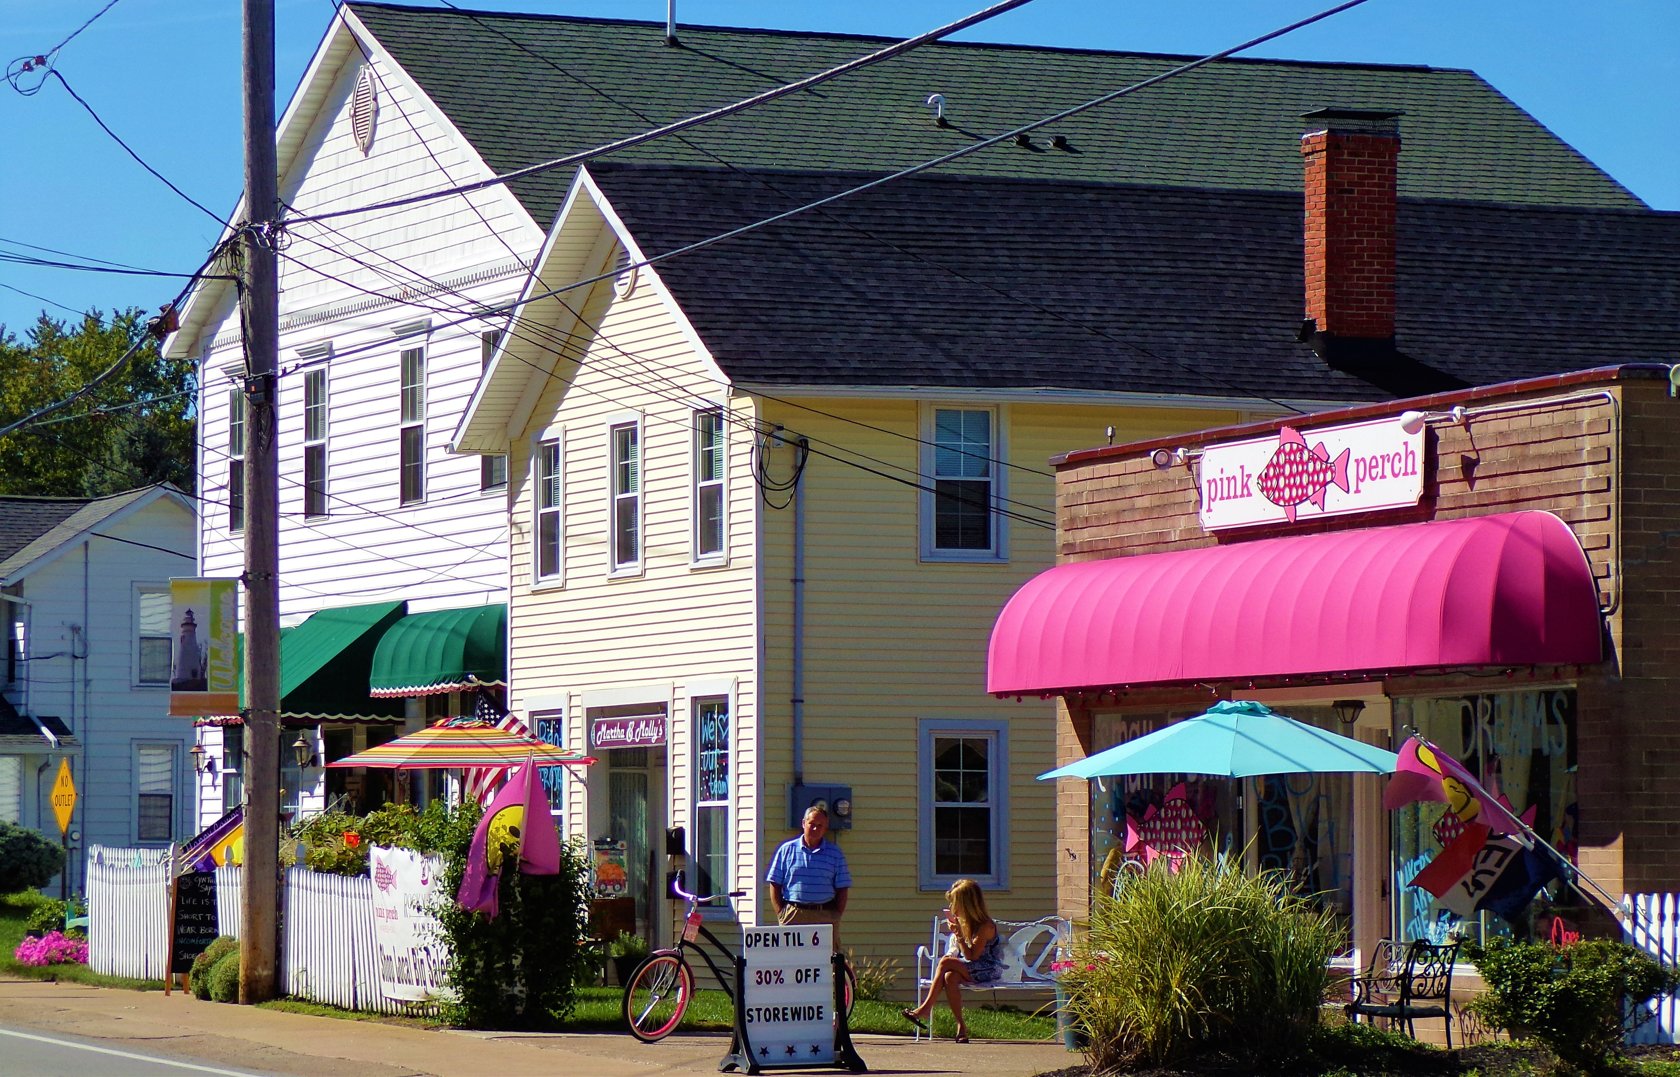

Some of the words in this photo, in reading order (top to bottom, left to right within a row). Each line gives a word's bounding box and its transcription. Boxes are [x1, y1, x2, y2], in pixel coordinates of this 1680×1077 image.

[1206, 465, 1252, 513] pink
[1354, 441, 1418, 494] perch
[209, 588, 235, 690] Welcome
[596, 723, 626, 745] Martha
[626, 720, 635, 742] &
[634, 719, 664, 744] Molly's
[701, 712, 715, 744] We
[1460, 690, 1569, 762] DREAMS
[60, 775, 69, 788] NO
[54, 794, 73, 807] OUTLET
[177, 909, 203, 921] SHORT
[206, 912, 217, 921] TO
[177, 923, 198, 936] WEAR
[745, 932, 780, 949] OPEN
[783, 931, 804, 947] TIL
[811, 930, 820, 946] 6
[755, 968, 785, 985] 30%
[795, 968, 821, 984] OFF
[746, 1005, 824, 1023] STOREWIDE
